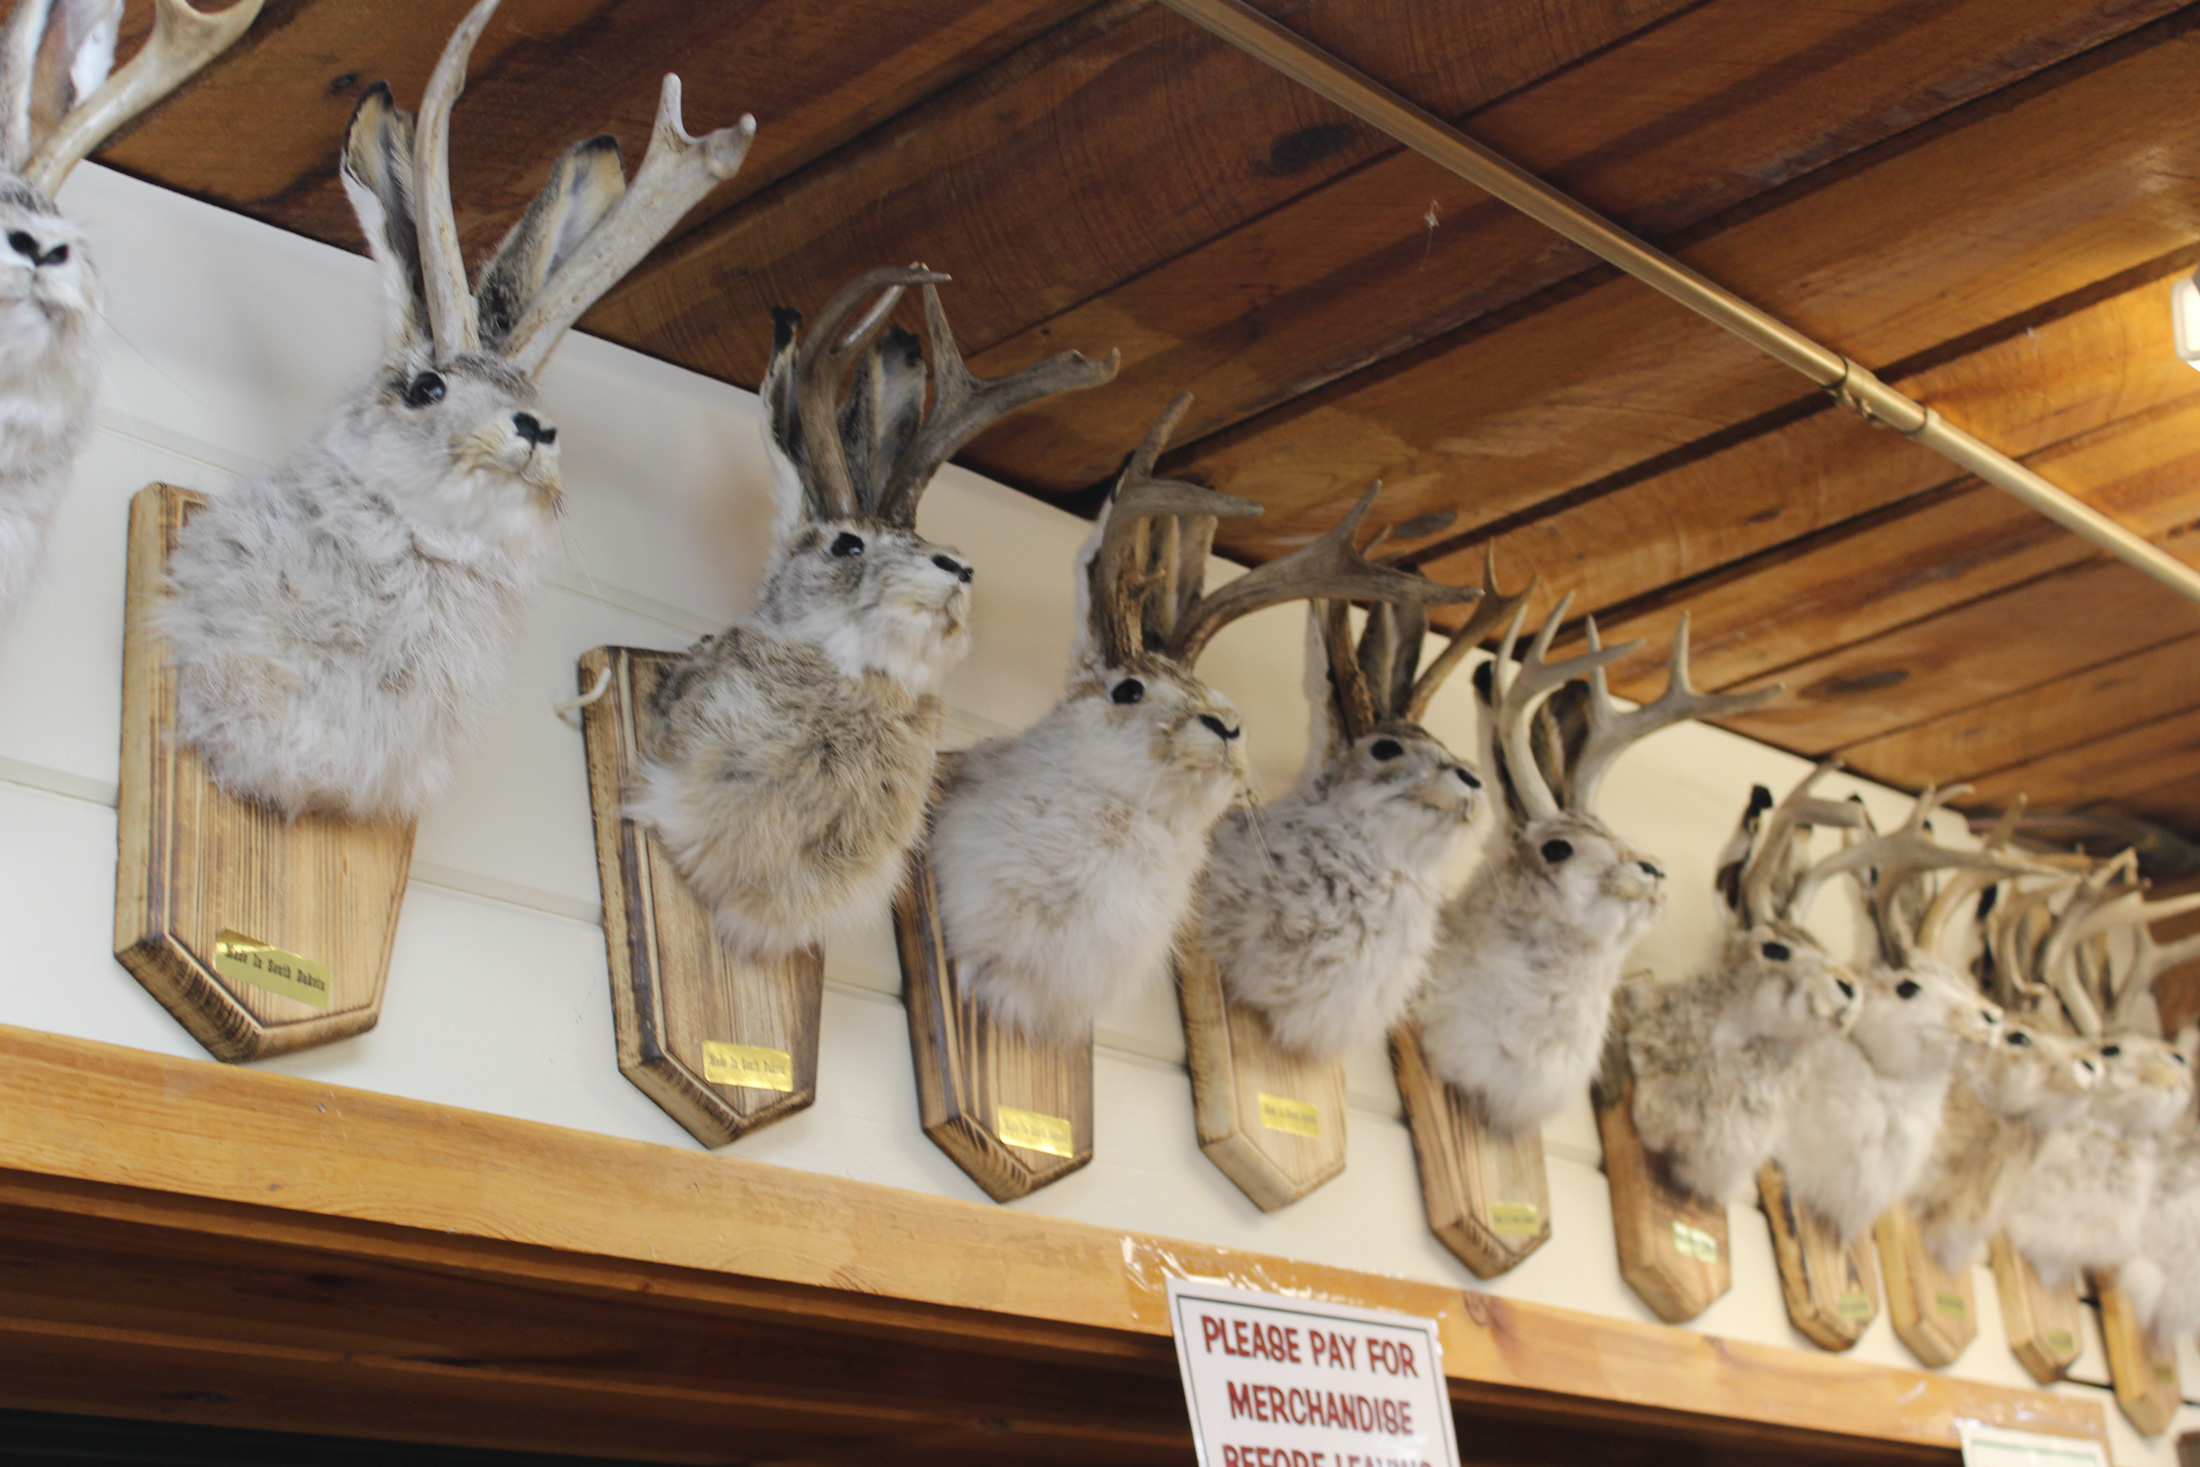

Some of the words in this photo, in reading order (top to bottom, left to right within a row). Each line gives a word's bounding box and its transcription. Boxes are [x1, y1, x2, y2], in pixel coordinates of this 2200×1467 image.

[267, 958, 291, 980] South
[297, 968, 325, 992] Dakota
[1201, 1315, 1301, 1364] PLEASE
[1308, 1329, 1357, 1370] PAY
[1366, 1336, 1419, 1378] FOR
[1226, 1380, 1414, 1436] MERCHANDISE
